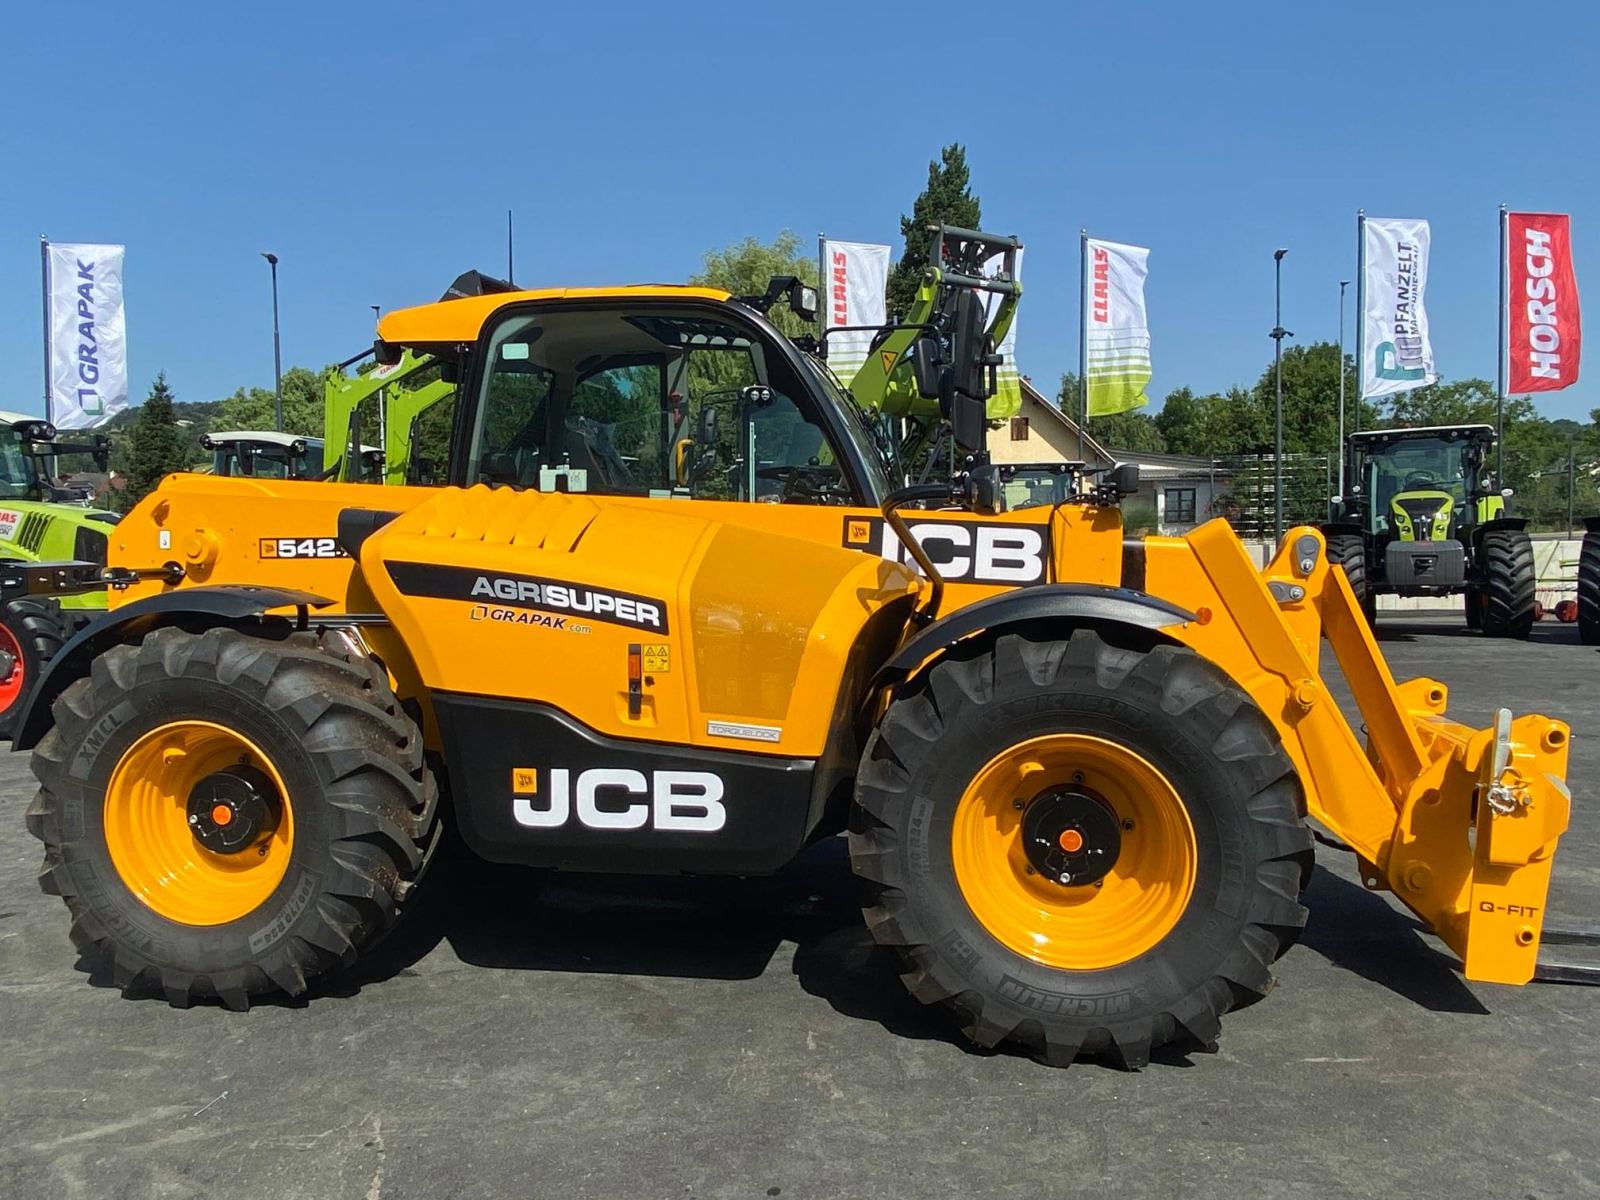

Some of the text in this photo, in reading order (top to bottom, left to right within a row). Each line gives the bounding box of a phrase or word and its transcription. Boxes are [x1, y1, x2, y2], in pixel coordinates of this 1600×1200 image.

[833, 251, 848, 326] CLAAS
[1094, 248, 1109, 323] CLAAS
[1394, 242, 1413, 335] PFANZELT
[1525, 228, 1561, 380] HORSCH
[77, 258, 99, 385] GRAPAK
[471, 576, 661, 627] AGRISUPER
[79, 713, 122, 764] XMCL
[711, 725, 777, 740] TORQUELOCK
[513, 768, 727, 832] JCB
[1480, 900, 1539, 918] Q-FIT
[1002, 980, 1131, 1017] MICHELIN
